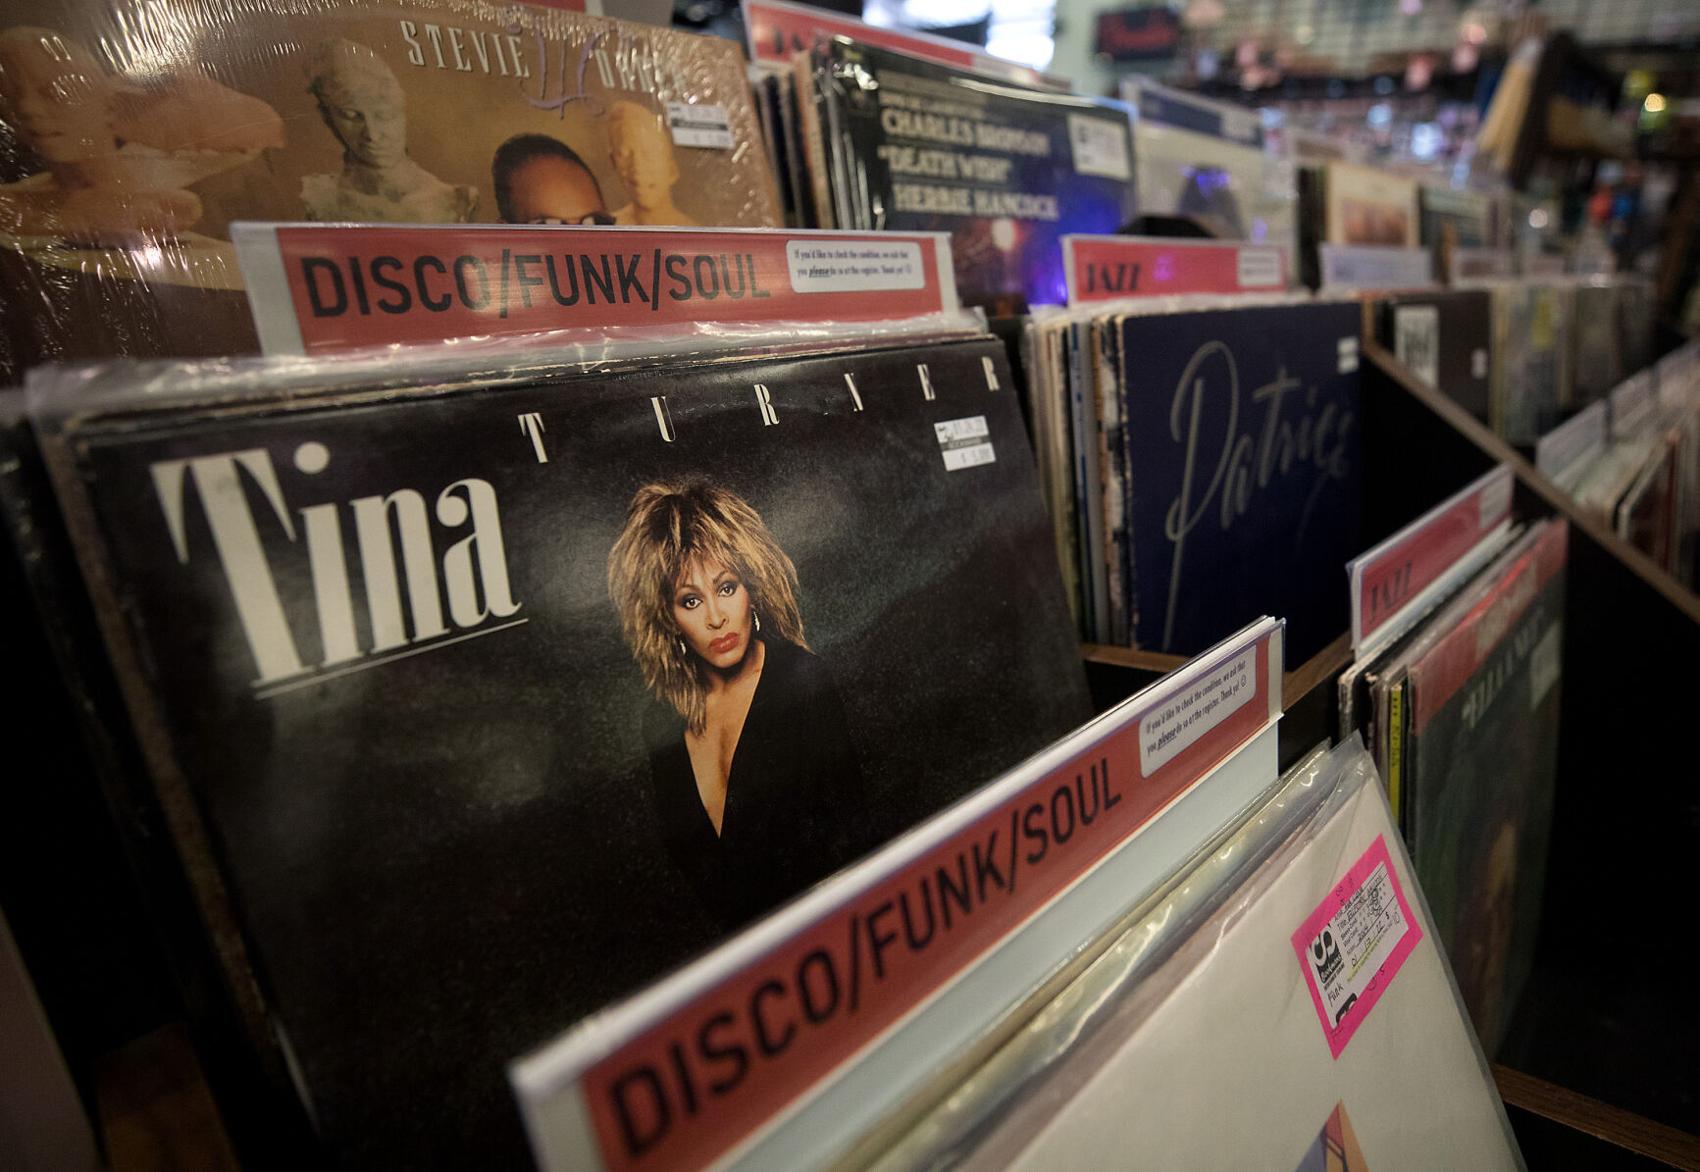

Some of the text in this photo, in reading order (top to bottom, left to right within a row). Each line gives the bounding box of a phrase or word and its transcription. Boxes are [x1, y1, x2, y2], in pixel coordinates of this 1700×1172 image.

[401, 21, 530, 78] STEVIE
[877, 107, 974, 146] CHARLES
[301, 248, 771, 318] DISCO/FUNK/SOUL
[808, 265, 830, 278] please
[150, 441, 523, 688] Tina
[1165, 706, 1175, 722] like
[1181, 695, 1194, 711] check
[1194, 690, 1202, 702] the
[1157, 729, 1177, 751] please
[610, 758, 1122, 1159] DISCO/FUNK/SOUL
